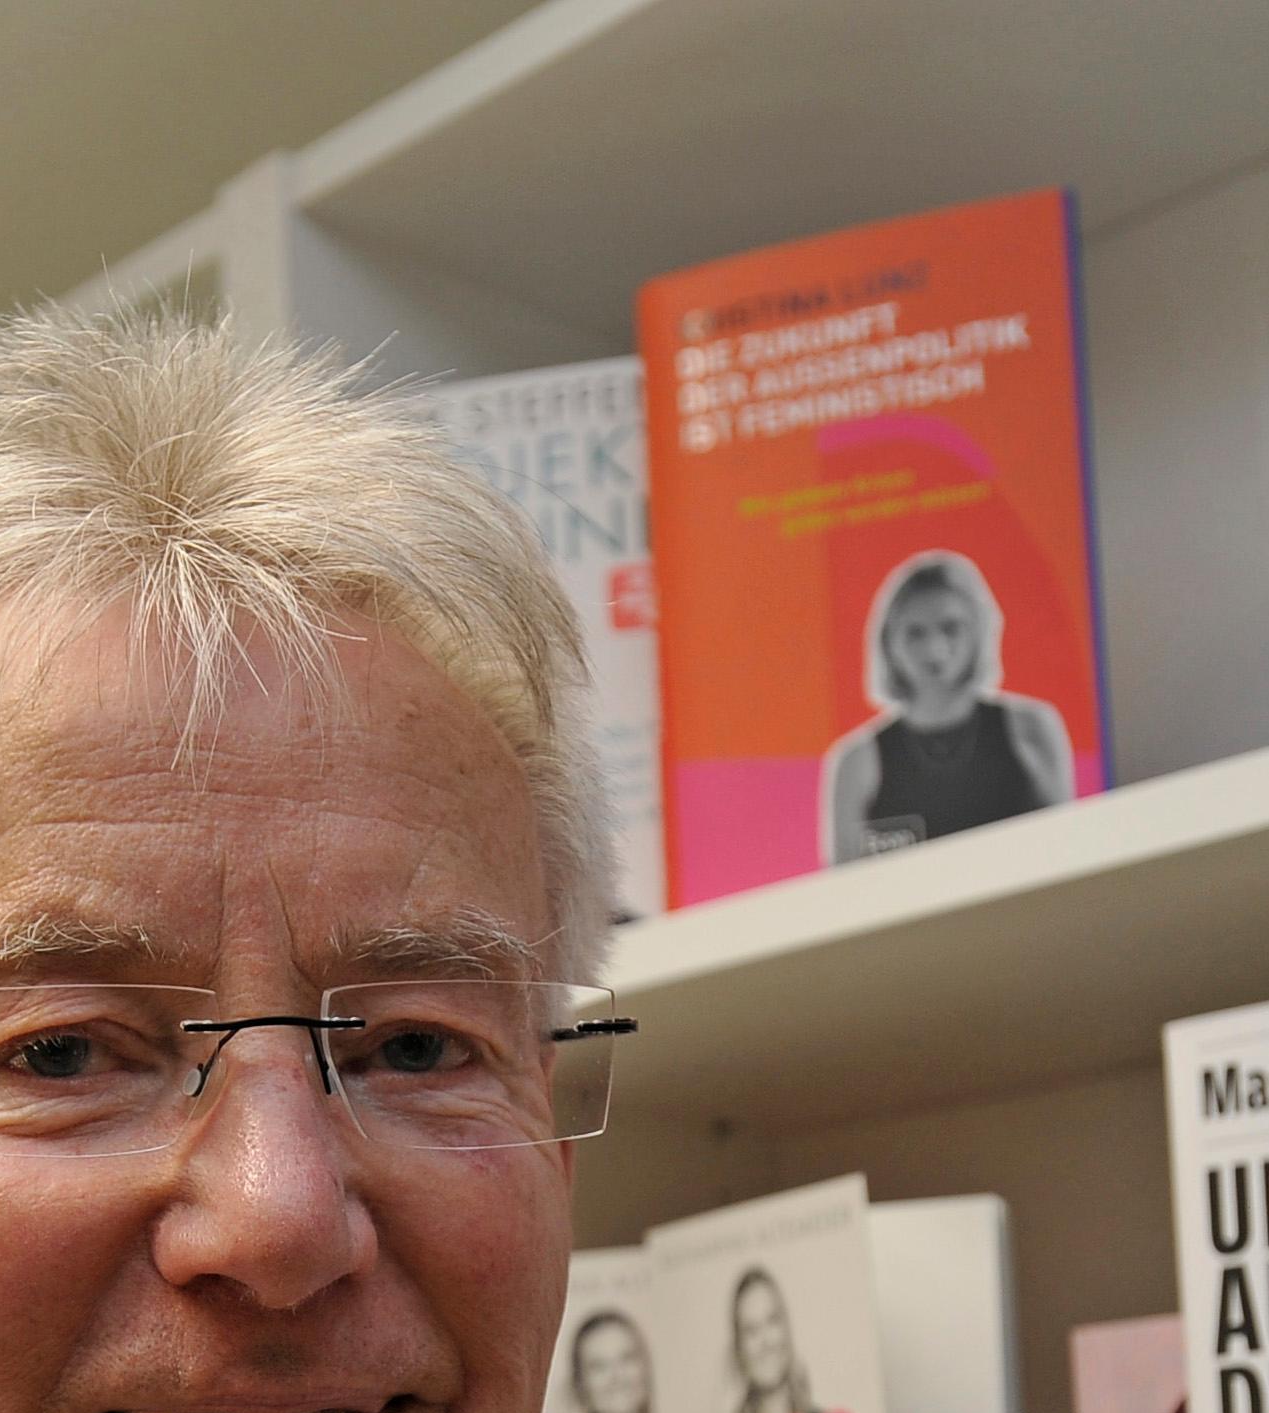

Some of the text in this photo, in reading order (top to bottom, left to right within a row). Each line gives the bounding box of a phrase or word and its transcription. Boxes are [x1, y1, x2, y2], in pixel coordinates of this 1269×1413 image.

[738, 301, 899, 369] ZUKUNFT
[751, 312, 1031, 400] AUSSENPOLITIK
[736, 360, 986, 440] FEMINISTISCH
[1202, 1066, 1269, 1118] Ma
[1207, 1162, 1269, 1254] U
